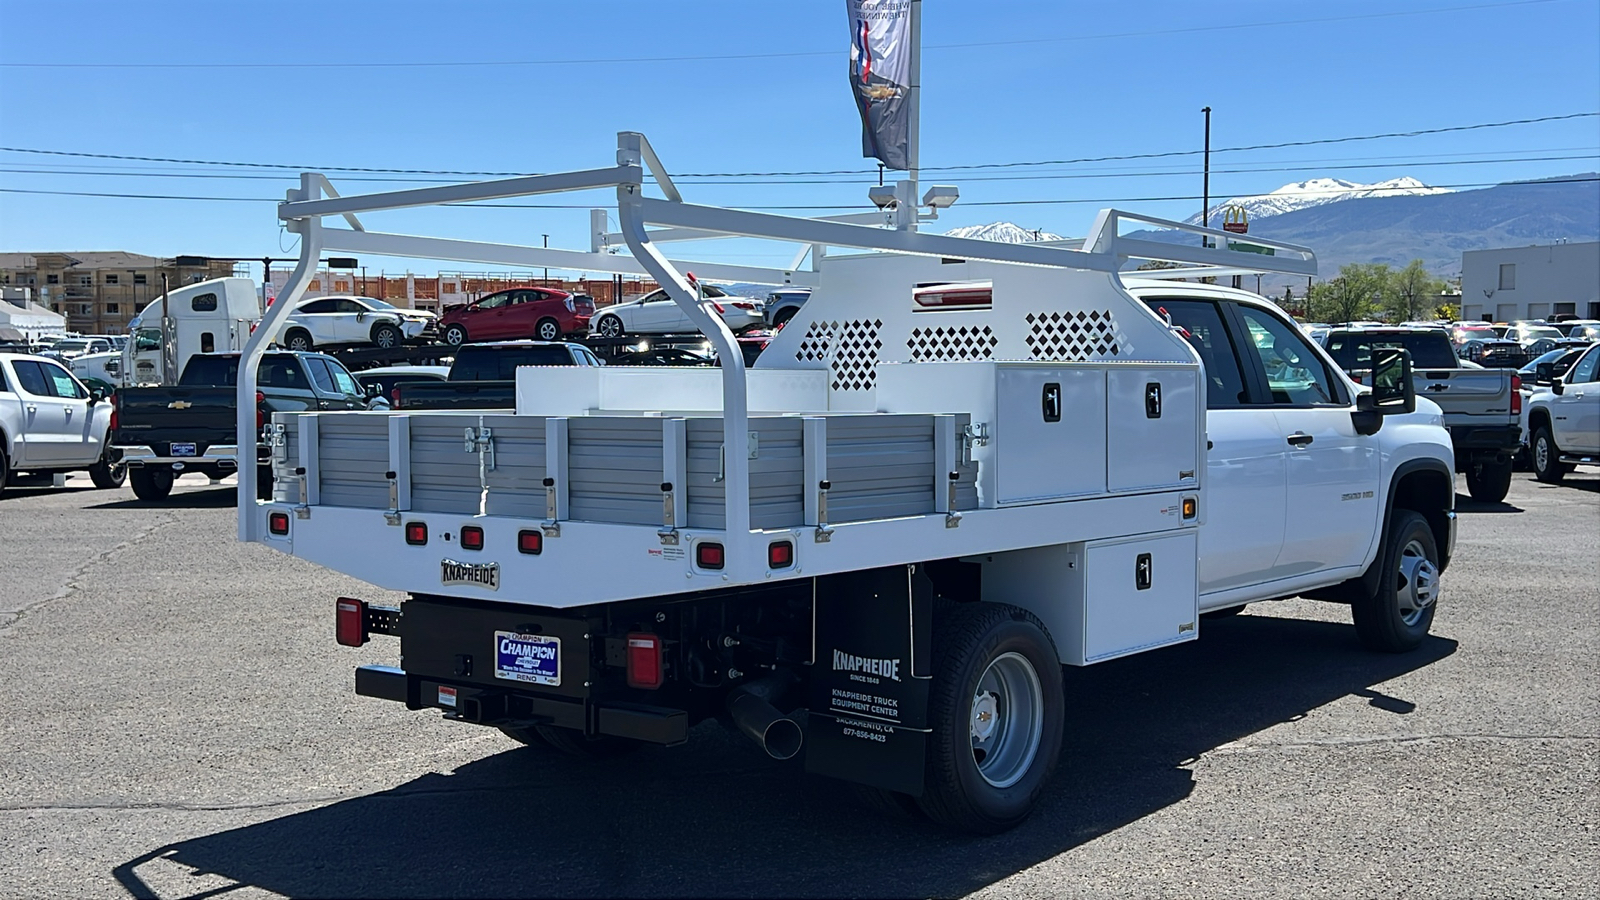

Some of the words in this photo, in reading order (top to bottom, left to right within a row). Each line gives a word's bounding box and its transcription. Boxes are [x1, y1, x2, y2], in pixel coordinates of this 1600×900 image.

[443, 562, 496, 587] KNAPHEIDE
[512, 634, 542, 643] CHAMPION
[500, 639, 556, 660] CHAMPION
[833, 648, 900, 682] KNAPHEIDE
[516, 674, 537, 682] RENO
[850, 674, 867, 683] SINCE
[832, 688, 872, 703] KNAPHEIDE
[873, 695, 898, 708] TRUCK
[832, 697, 870, 712] EQUIPMENT
[871, 705, 898, 717] CENTER
